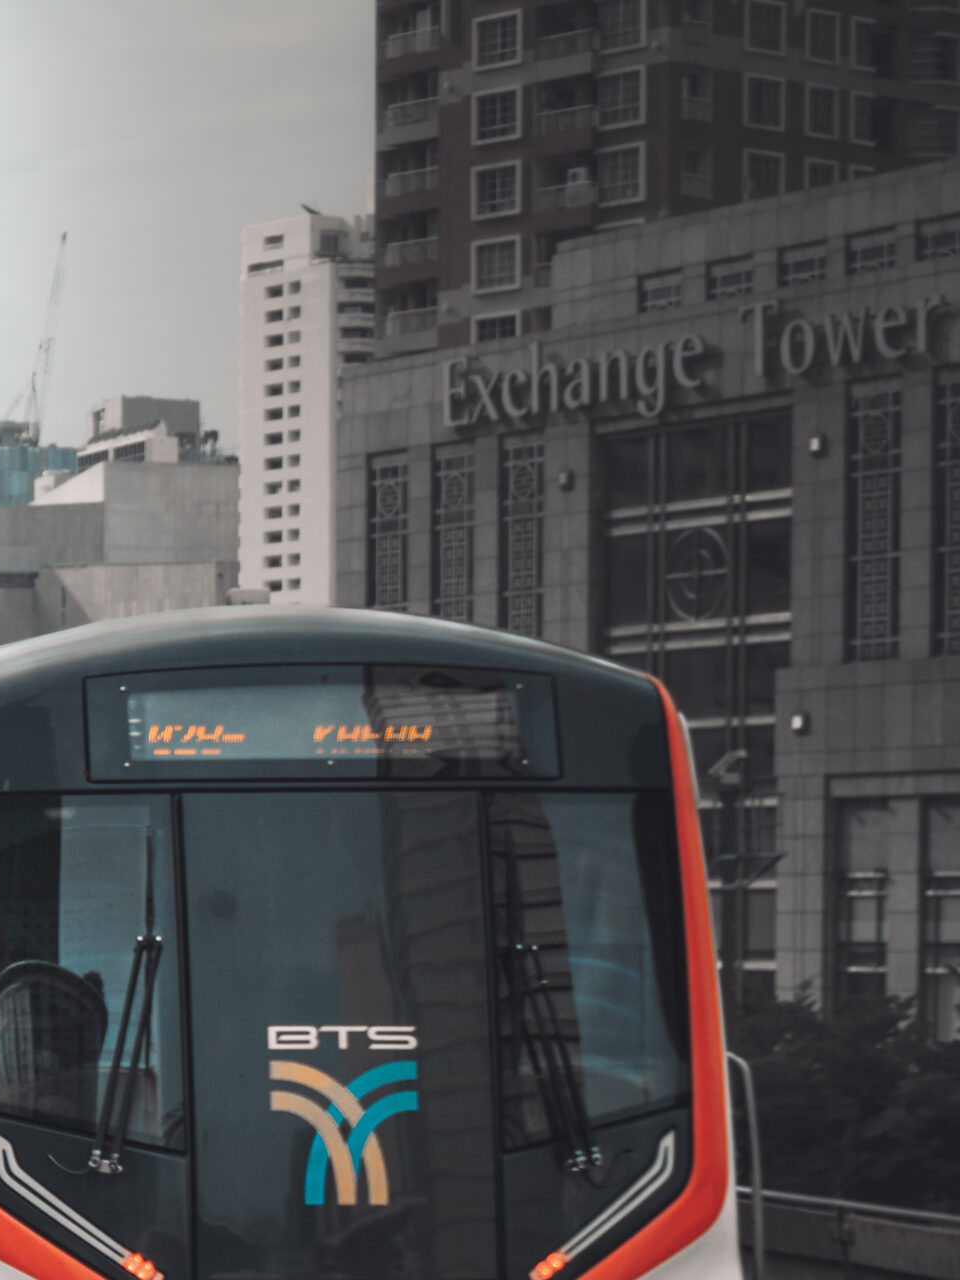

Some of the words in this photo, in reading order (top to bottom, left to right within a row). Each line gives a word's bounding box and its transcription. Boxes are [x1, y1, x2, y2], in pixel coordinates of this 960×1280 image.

[442, 333, 706, 428] Exchange
[741, 295, 940, 377] Tower
[267, 1025, 418, 1050] BTS
